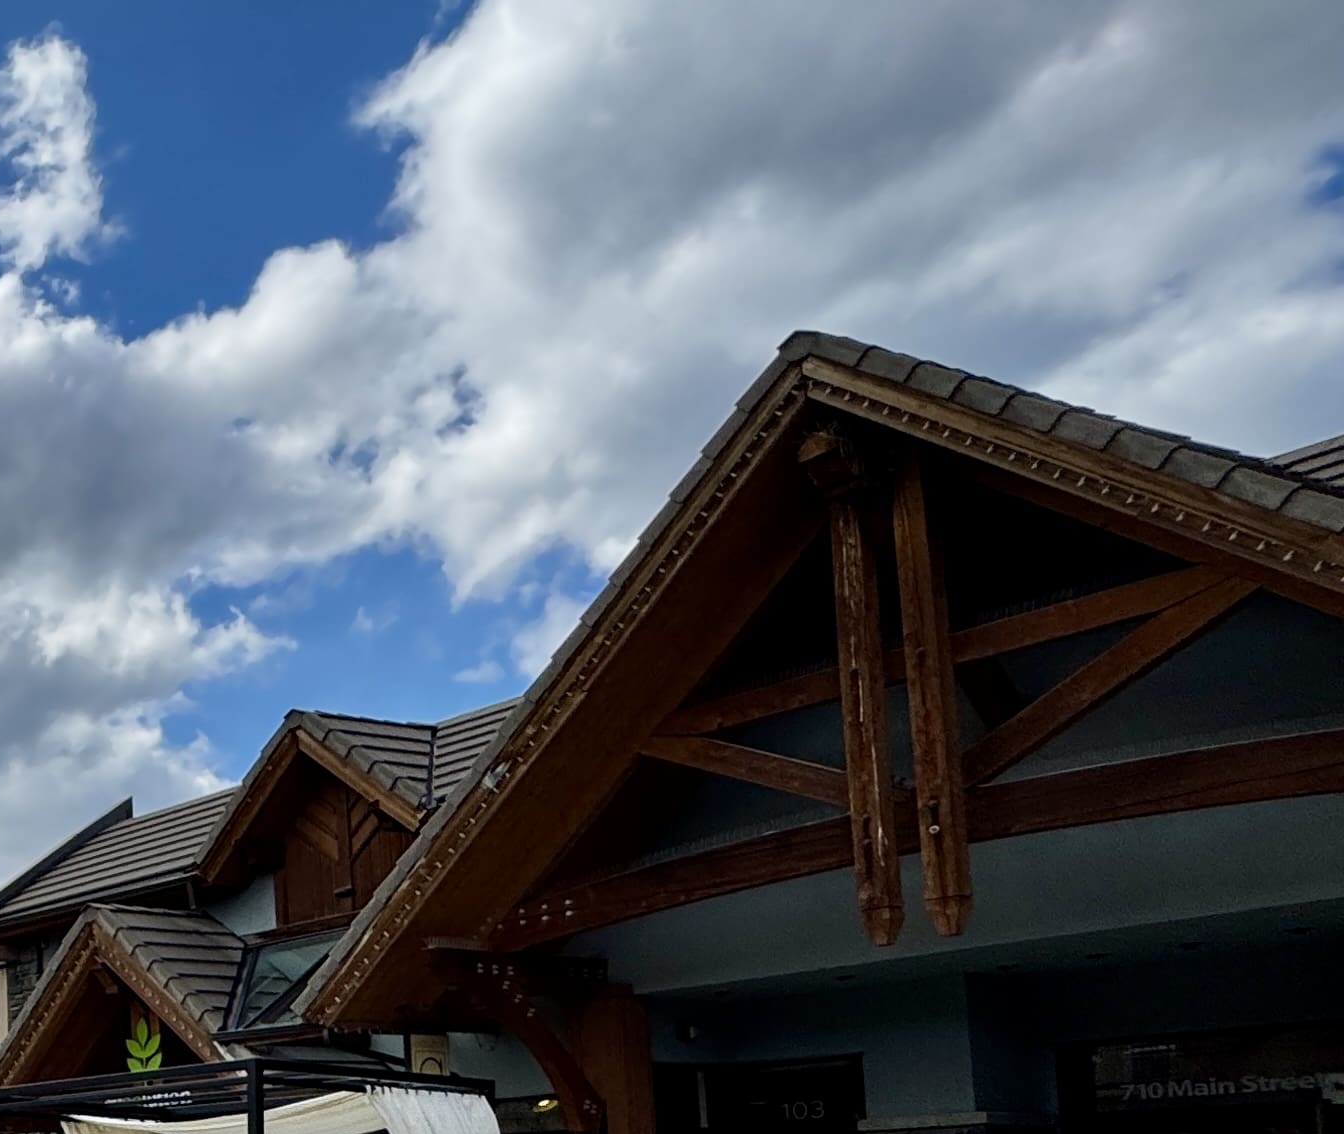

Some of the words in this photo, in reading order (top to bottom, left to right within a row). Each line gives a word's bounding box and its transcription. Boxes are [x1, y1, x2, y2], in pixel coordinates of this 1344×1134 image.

[1120, 1082, 1164, 1102] 710
[1167, 1076, 1236, 1098] Main
[784, 1099, 824, 1120] 103
